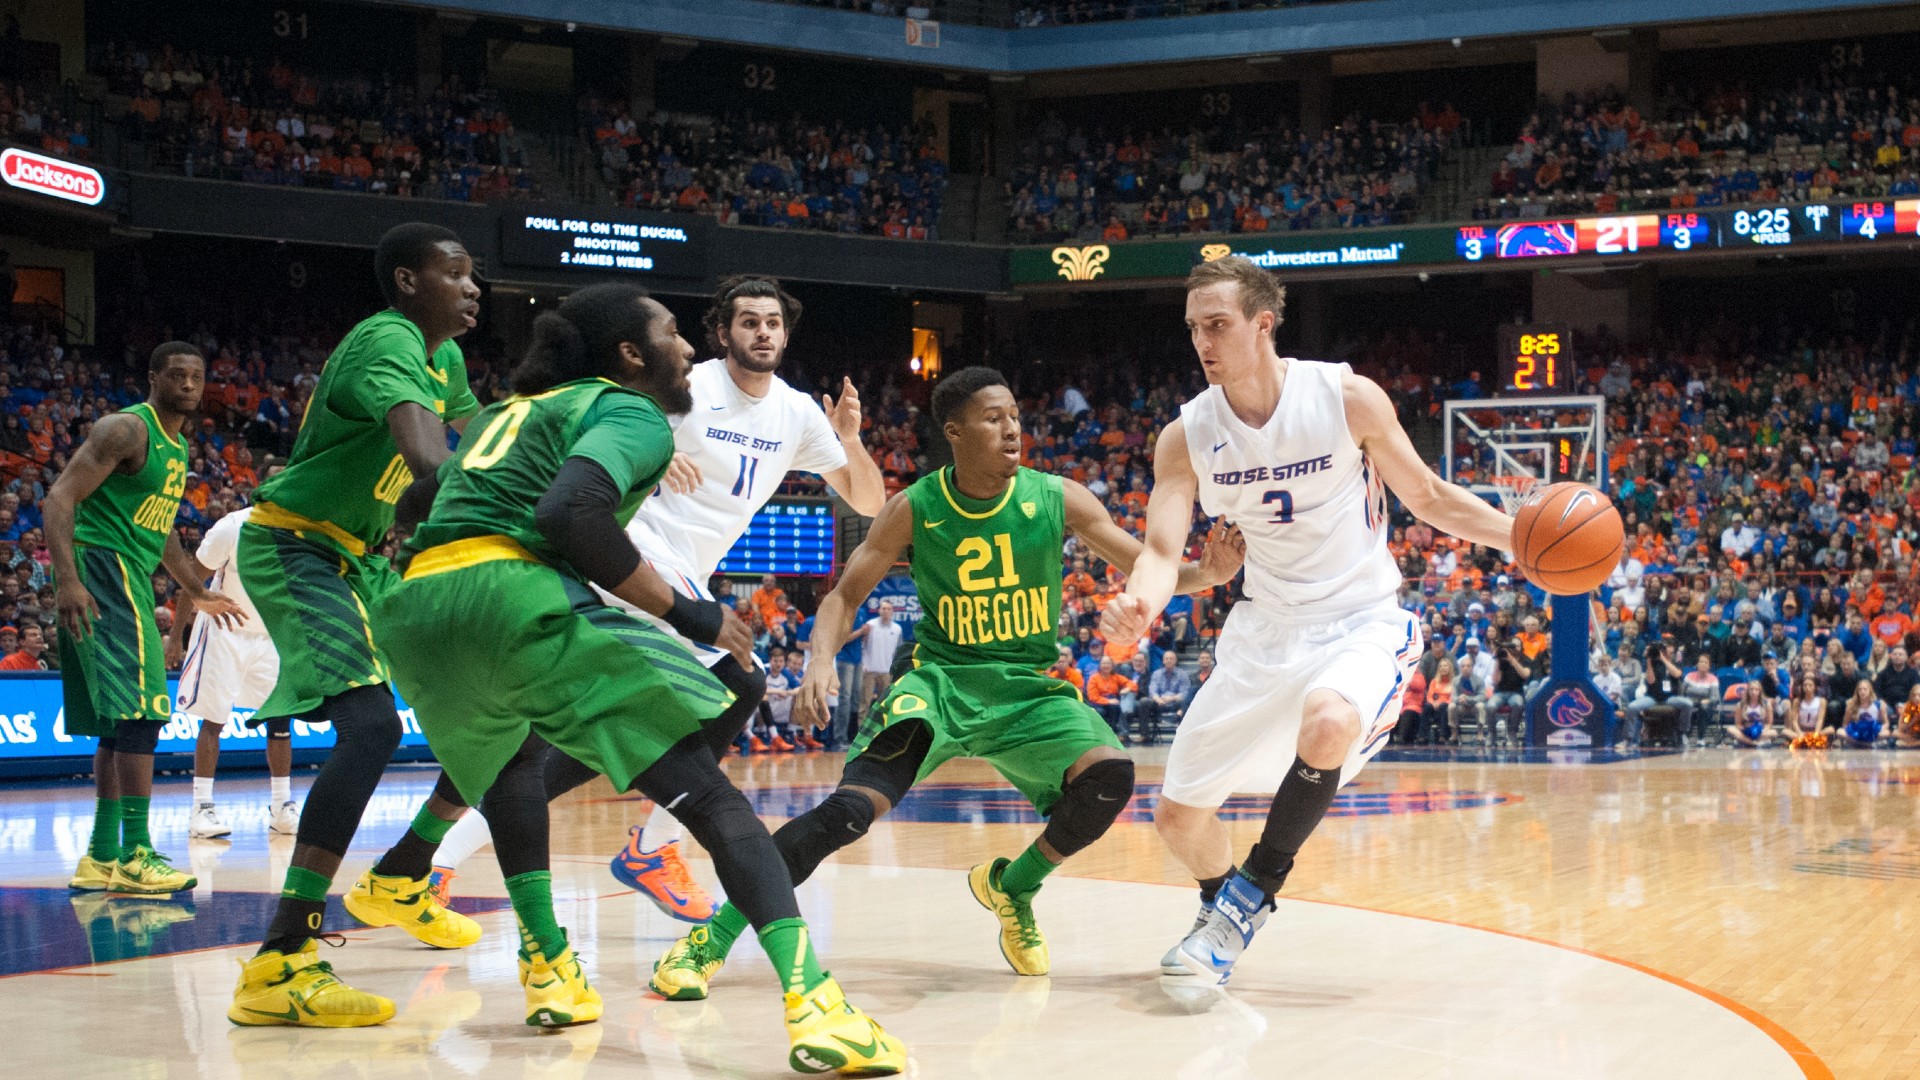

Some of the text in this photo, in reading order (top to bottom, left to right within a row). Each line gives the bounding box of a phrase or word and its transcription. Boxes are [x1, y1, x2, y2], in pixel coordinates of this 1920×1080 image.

[273, 10, 308, 39] 31
[744, 64, 776, 90] 32
[10, 156, 96, 196] Jacksons
[1667, 213, 1698, 229] FLS
[1734, 208, 1790, 235] 8:25
[1805, 205, 1829, 217] PER
[1853, 202, 1885, 218] FLS
[525, 216, 687, 242] FOUL FOR ON THE DUCKS,
[1460, 227, 1487, 239] TOL
[1595, 217, 1638, 253] 21
[1812, 217, 1822, 231] 1
[1859, 217, 1877, 239] 4
[574, 237, 640, 252] SHOOTING
[1465, 239, 1482, 260] 3
[1673, 228, 1691, 249] 3
[1760, 232, 1791, 244] POSS
[560, 252, 653, 270] 2 JAMES WEBB
[289, 262, 307, 288] 9
[1520, 333, 1560, 355] 8:25
[1514, 355, 1555, 389] 21
[461, 400, 532, 471] 0
[706, 427, 782, 453] BOISE STAT
[163, 458, 185, 498] 23
[731, 453, 759, 499] 11
[1212, 454, 1332, 485] BOSE STATE
[133, 494, 179, 535] OREG
[1261, 490, 1295, 524] 3
[955, 533, 1020, 592] 21
[938, 586, 1051, 645] OREGON
